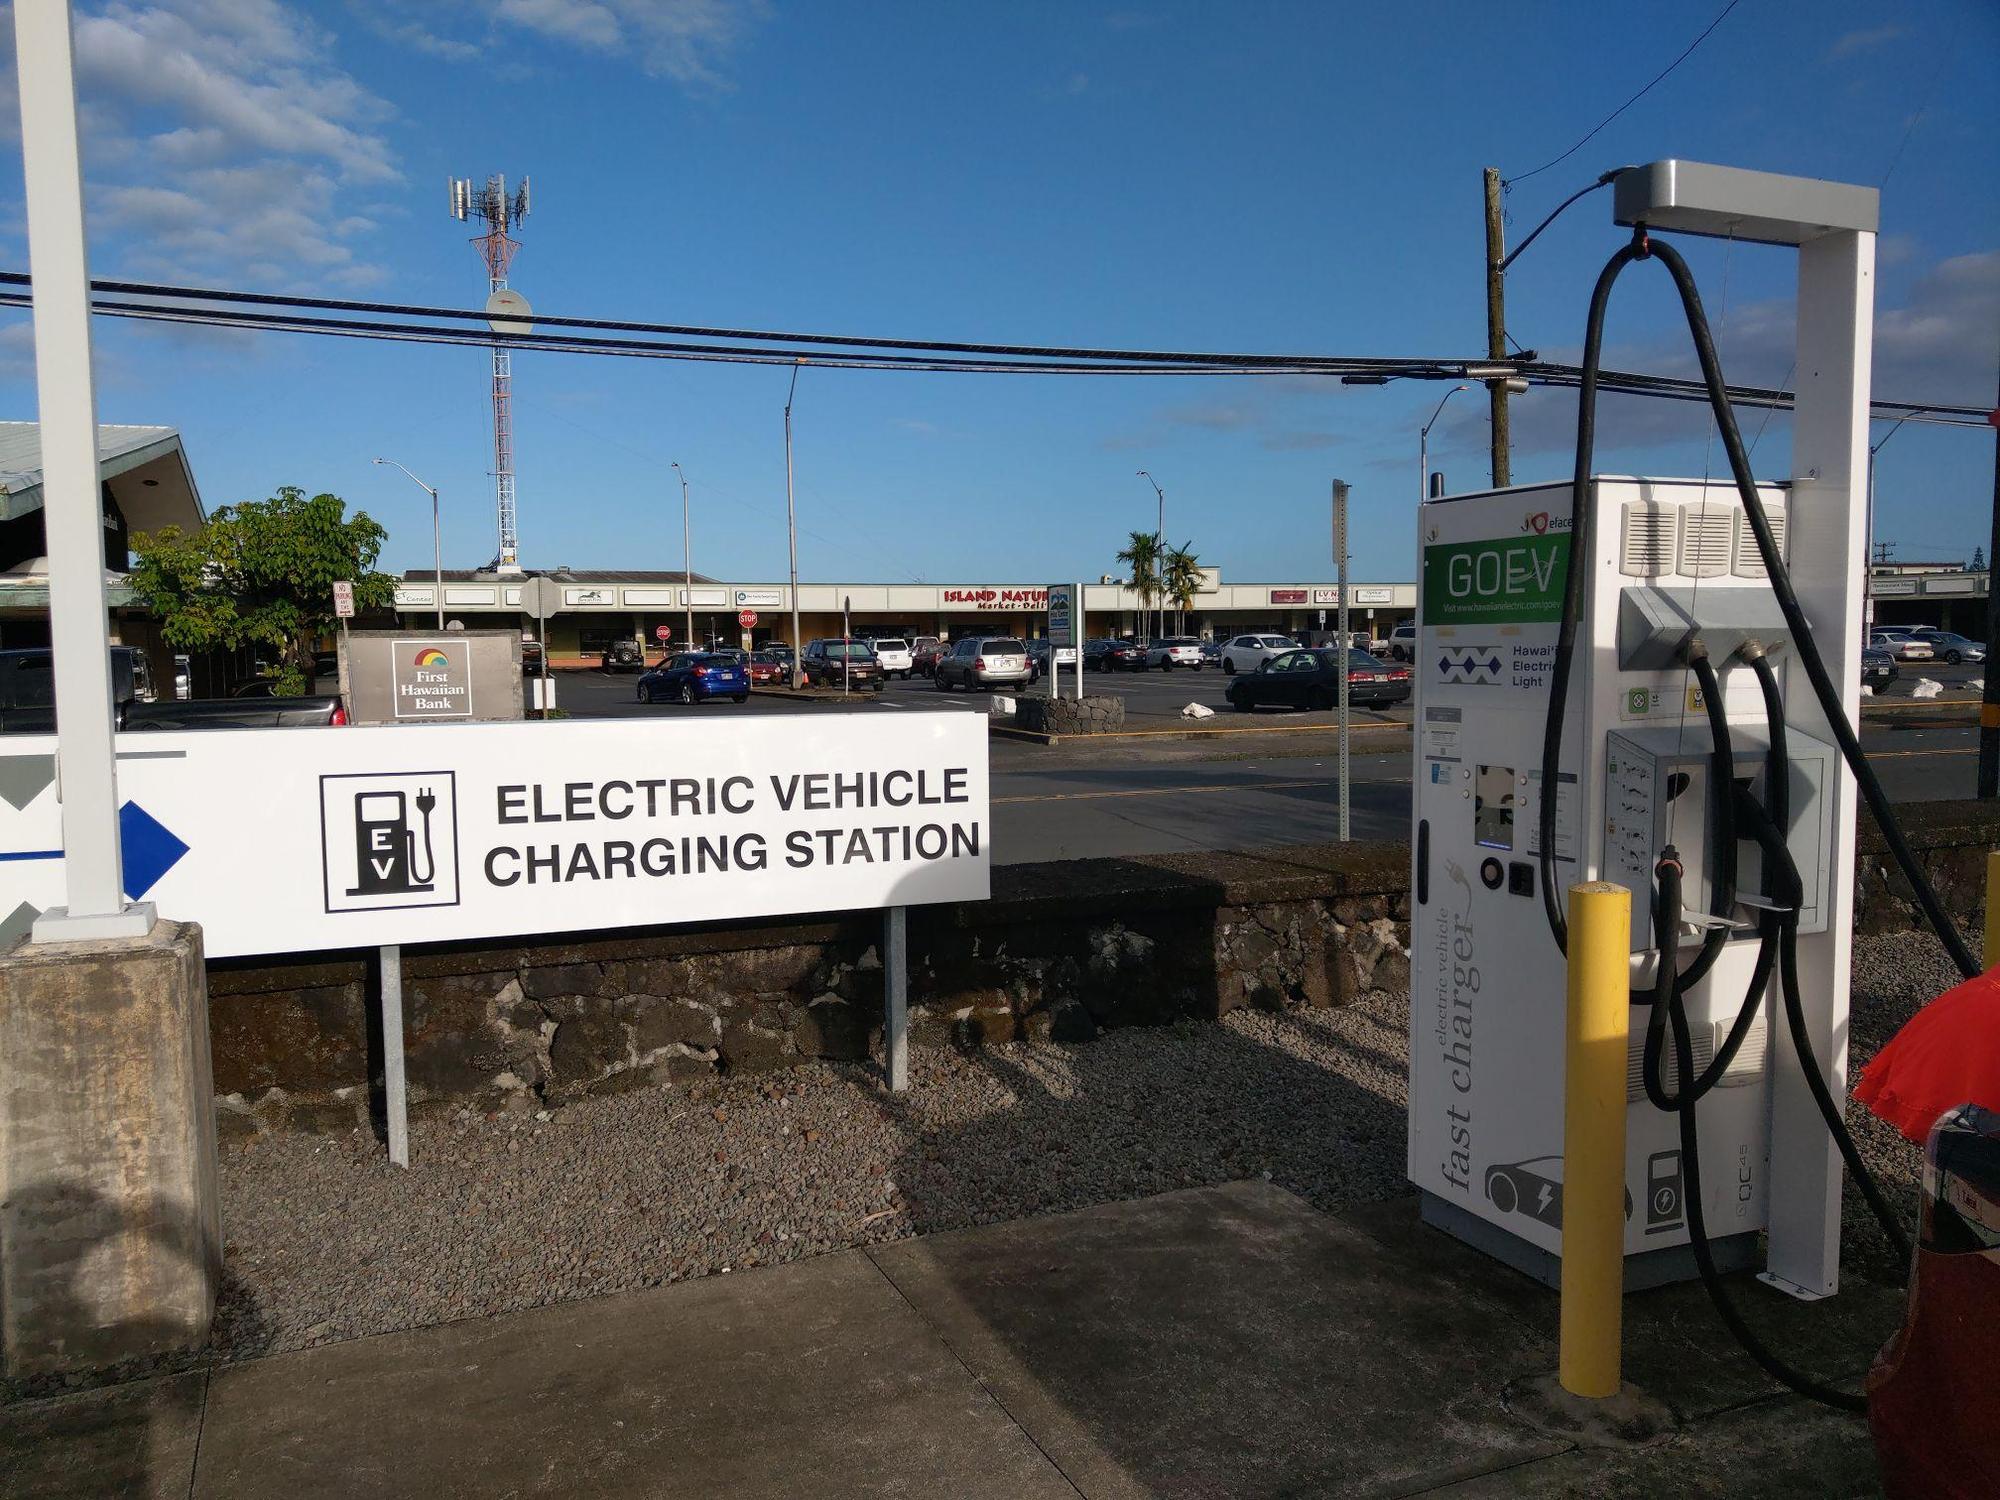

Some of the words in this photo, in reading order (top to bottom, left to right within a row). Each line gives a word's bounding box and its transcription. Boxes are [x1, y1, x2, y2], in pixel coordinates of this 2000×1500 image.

[1550, 517, 1572, 528] eface
[1448, 546, 1558, 597] GOEV
[338, 584, 346, 592] NO
[944, 590, 997, 602] ISLAND
[401, 684, 464, 696] Hawaiian
[416, 671, 448, 683] First
[1512, 676, 1544, 689] Light
[416, 697, 452, 709] Bank
[498, 775, 754, 825] ELECTRIC
[770, 768, 970, 812] VEHICLE
[484, 832, 767, 887] CHARGING
[785, 822, 980, 868] STATION
[1436, 908, 1448, 972] vehicle
[1435, 978, 1448, 1046] electric
[1443, 912, 1480, 1094] charger
[1441, 1104, 1471, 1194] fast
